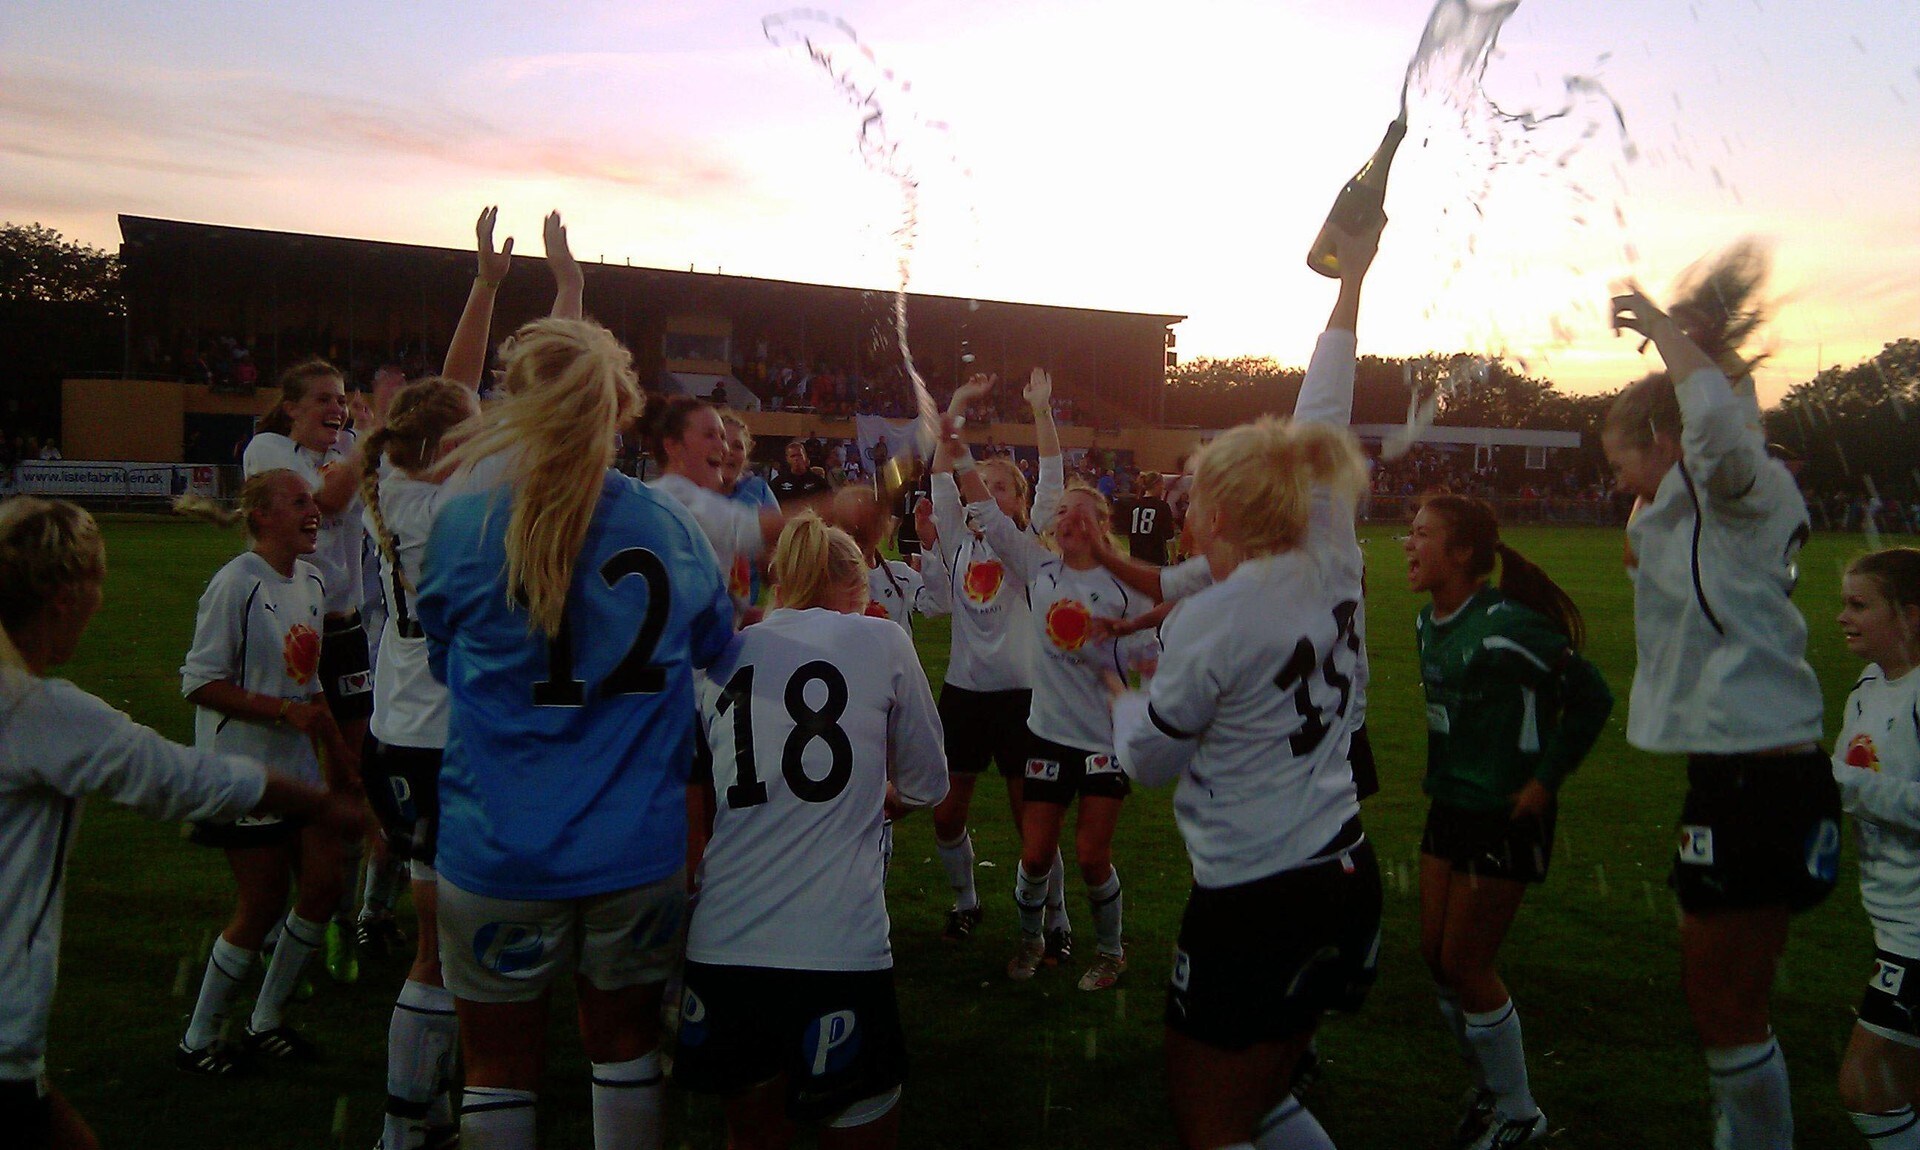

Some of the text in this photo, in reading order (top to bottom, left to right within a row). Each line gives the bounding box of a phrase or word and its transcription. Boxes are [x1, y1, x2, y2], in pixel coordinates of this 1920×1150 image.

[1131, 507, 1156, 534] 18
[715, 659, 854, 809] 18
[810, 1009, 856, 1078] P
